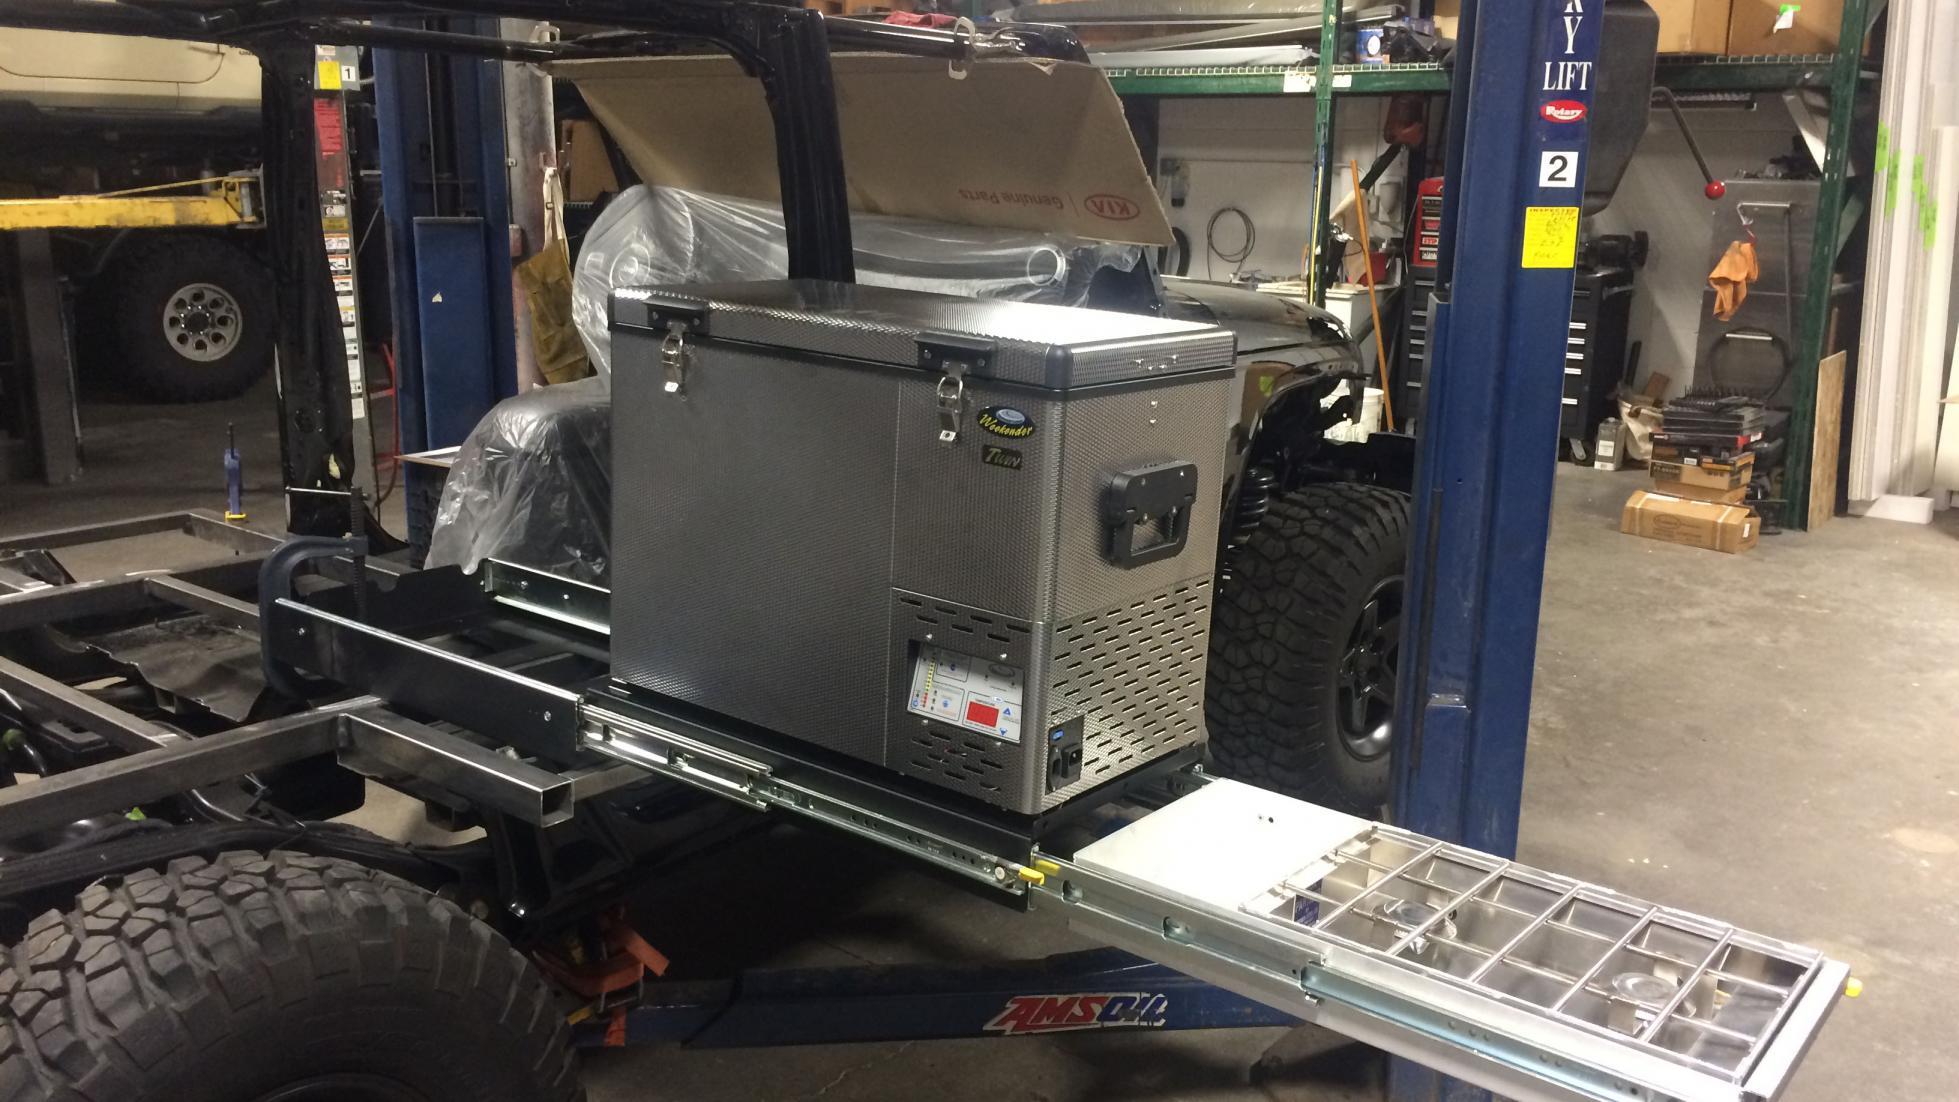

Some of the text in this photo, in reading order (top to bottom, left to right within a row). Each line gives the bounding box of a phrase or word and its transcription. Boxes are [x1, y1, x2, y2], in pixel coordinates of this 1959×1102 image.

[344, 68, 351, 79] 1
[1542, 61, 1592, 90] LIFT
[1545, 105, 1583, 119] Rotary
[1547, 155, 1568, 181] 2
[958, 189, 1131, 215] KIA Genuine Parts
[980, 413, 1033, 437] Weekender
